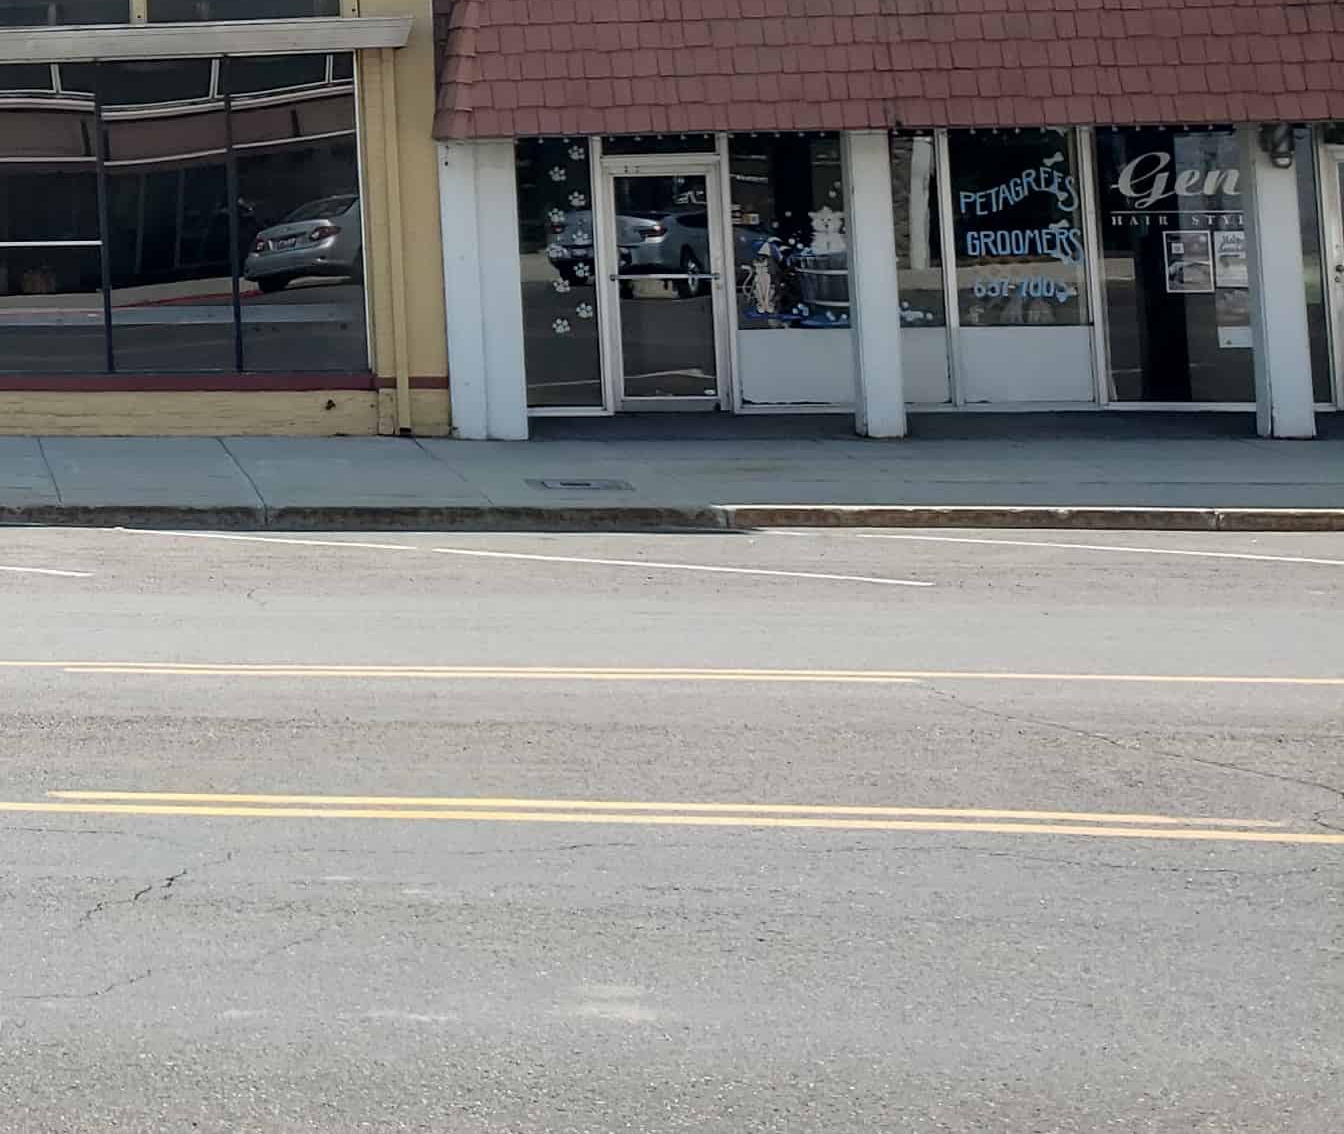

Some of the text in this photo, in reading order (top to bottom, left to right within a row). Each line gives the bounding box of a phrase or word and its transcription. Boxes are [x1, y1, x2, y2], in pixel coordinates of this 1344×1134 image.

[959, 167, 1079, 215] PETAGREES
[1112, 215, 1169, 226] HAIR
[966, 228, 1084, 265] GROOMERS
